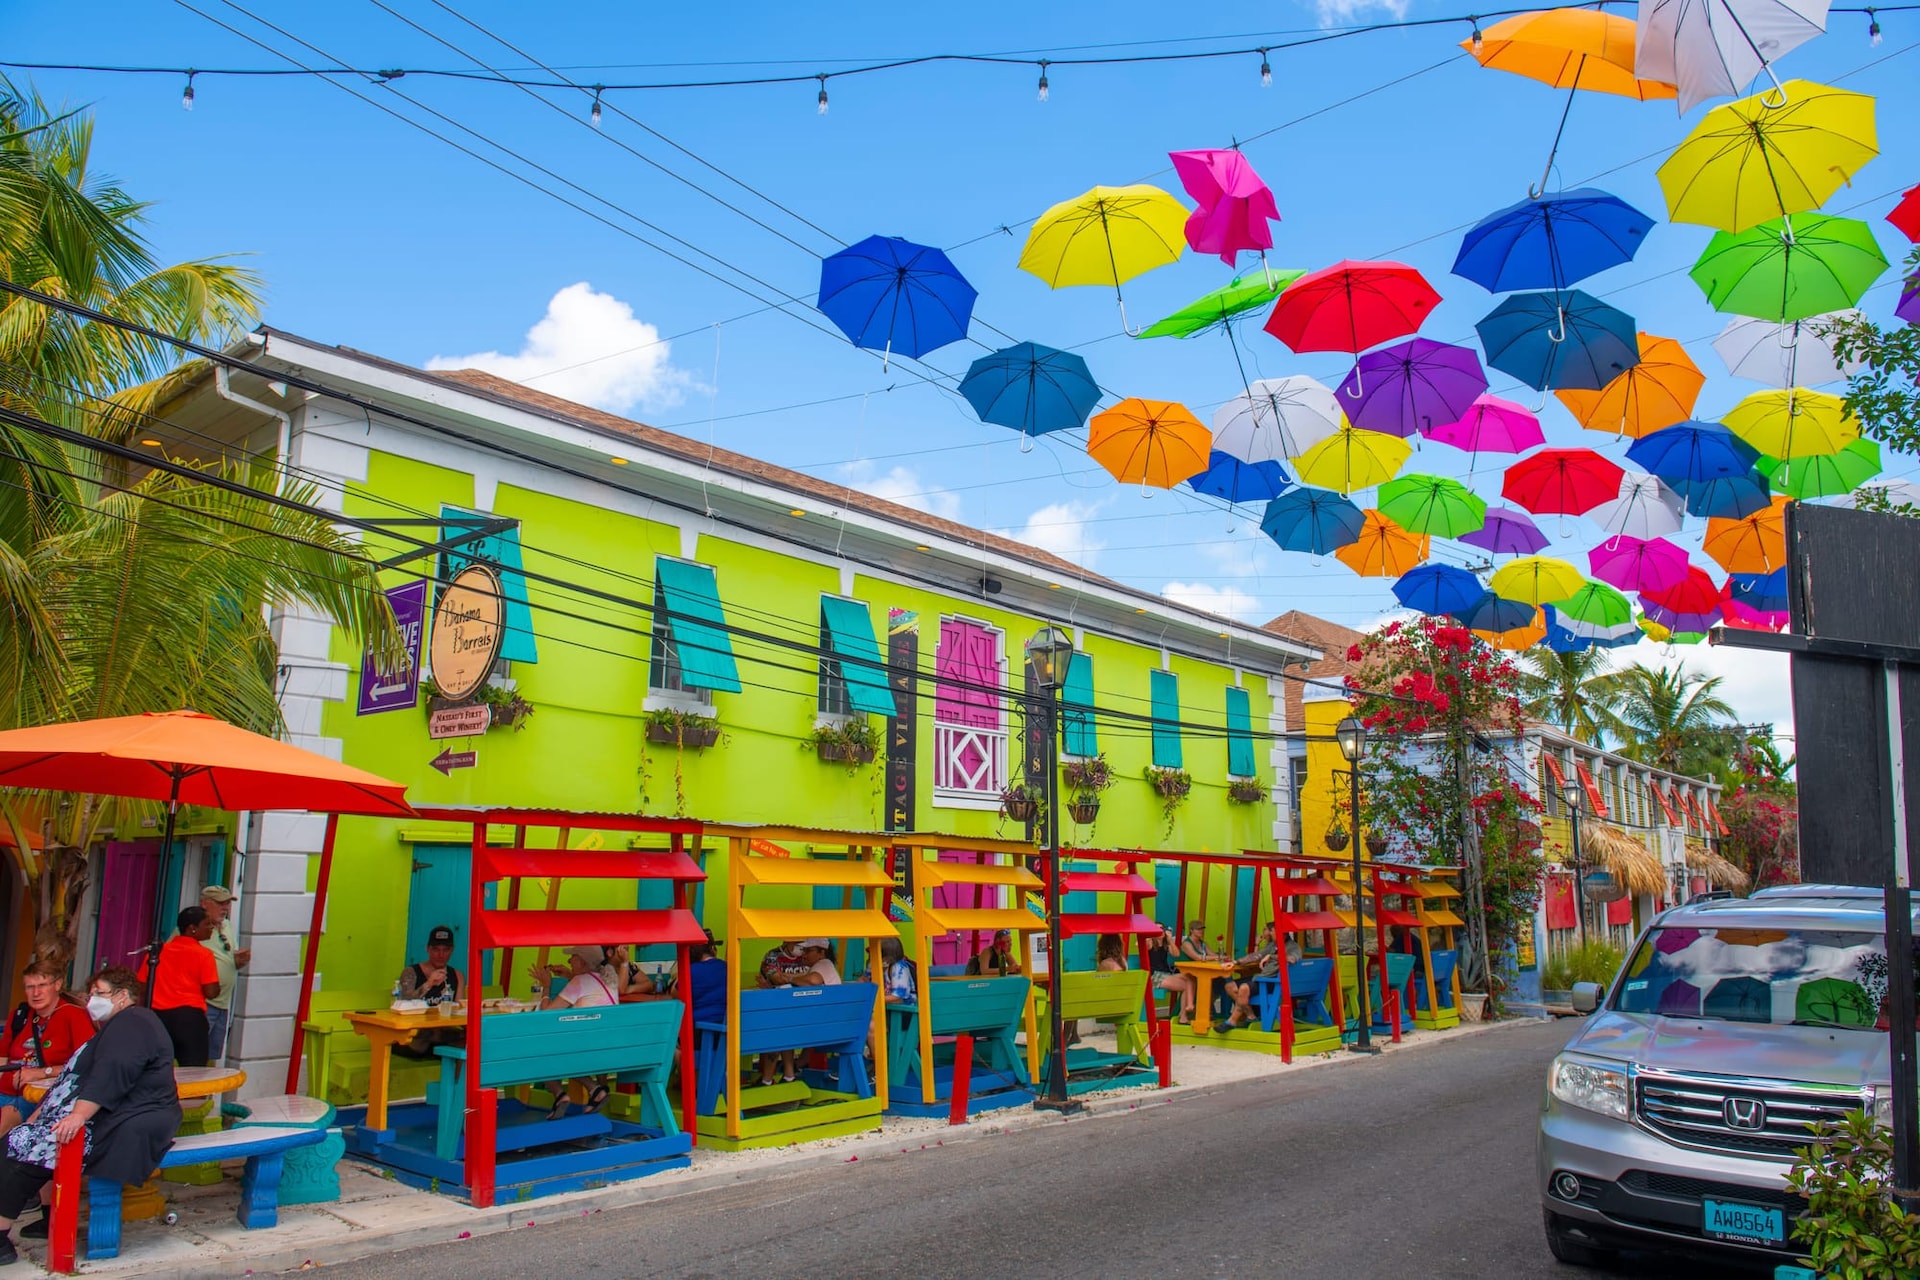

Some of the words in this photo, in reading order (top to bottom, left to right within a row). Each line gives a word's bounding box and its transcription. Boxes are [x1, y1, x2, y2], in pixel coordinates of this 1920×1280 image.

[443, 600, 481, 628] Bahama
[452, 625, 492, 654] Barrels
[896, 640, 910, 747] VILLAGE
[894, 757, 907, 887] HEITAGE
[1714, 1209, 1774, 1234] AW8564
[1725, 1234, 1761, 1244] HONDA
